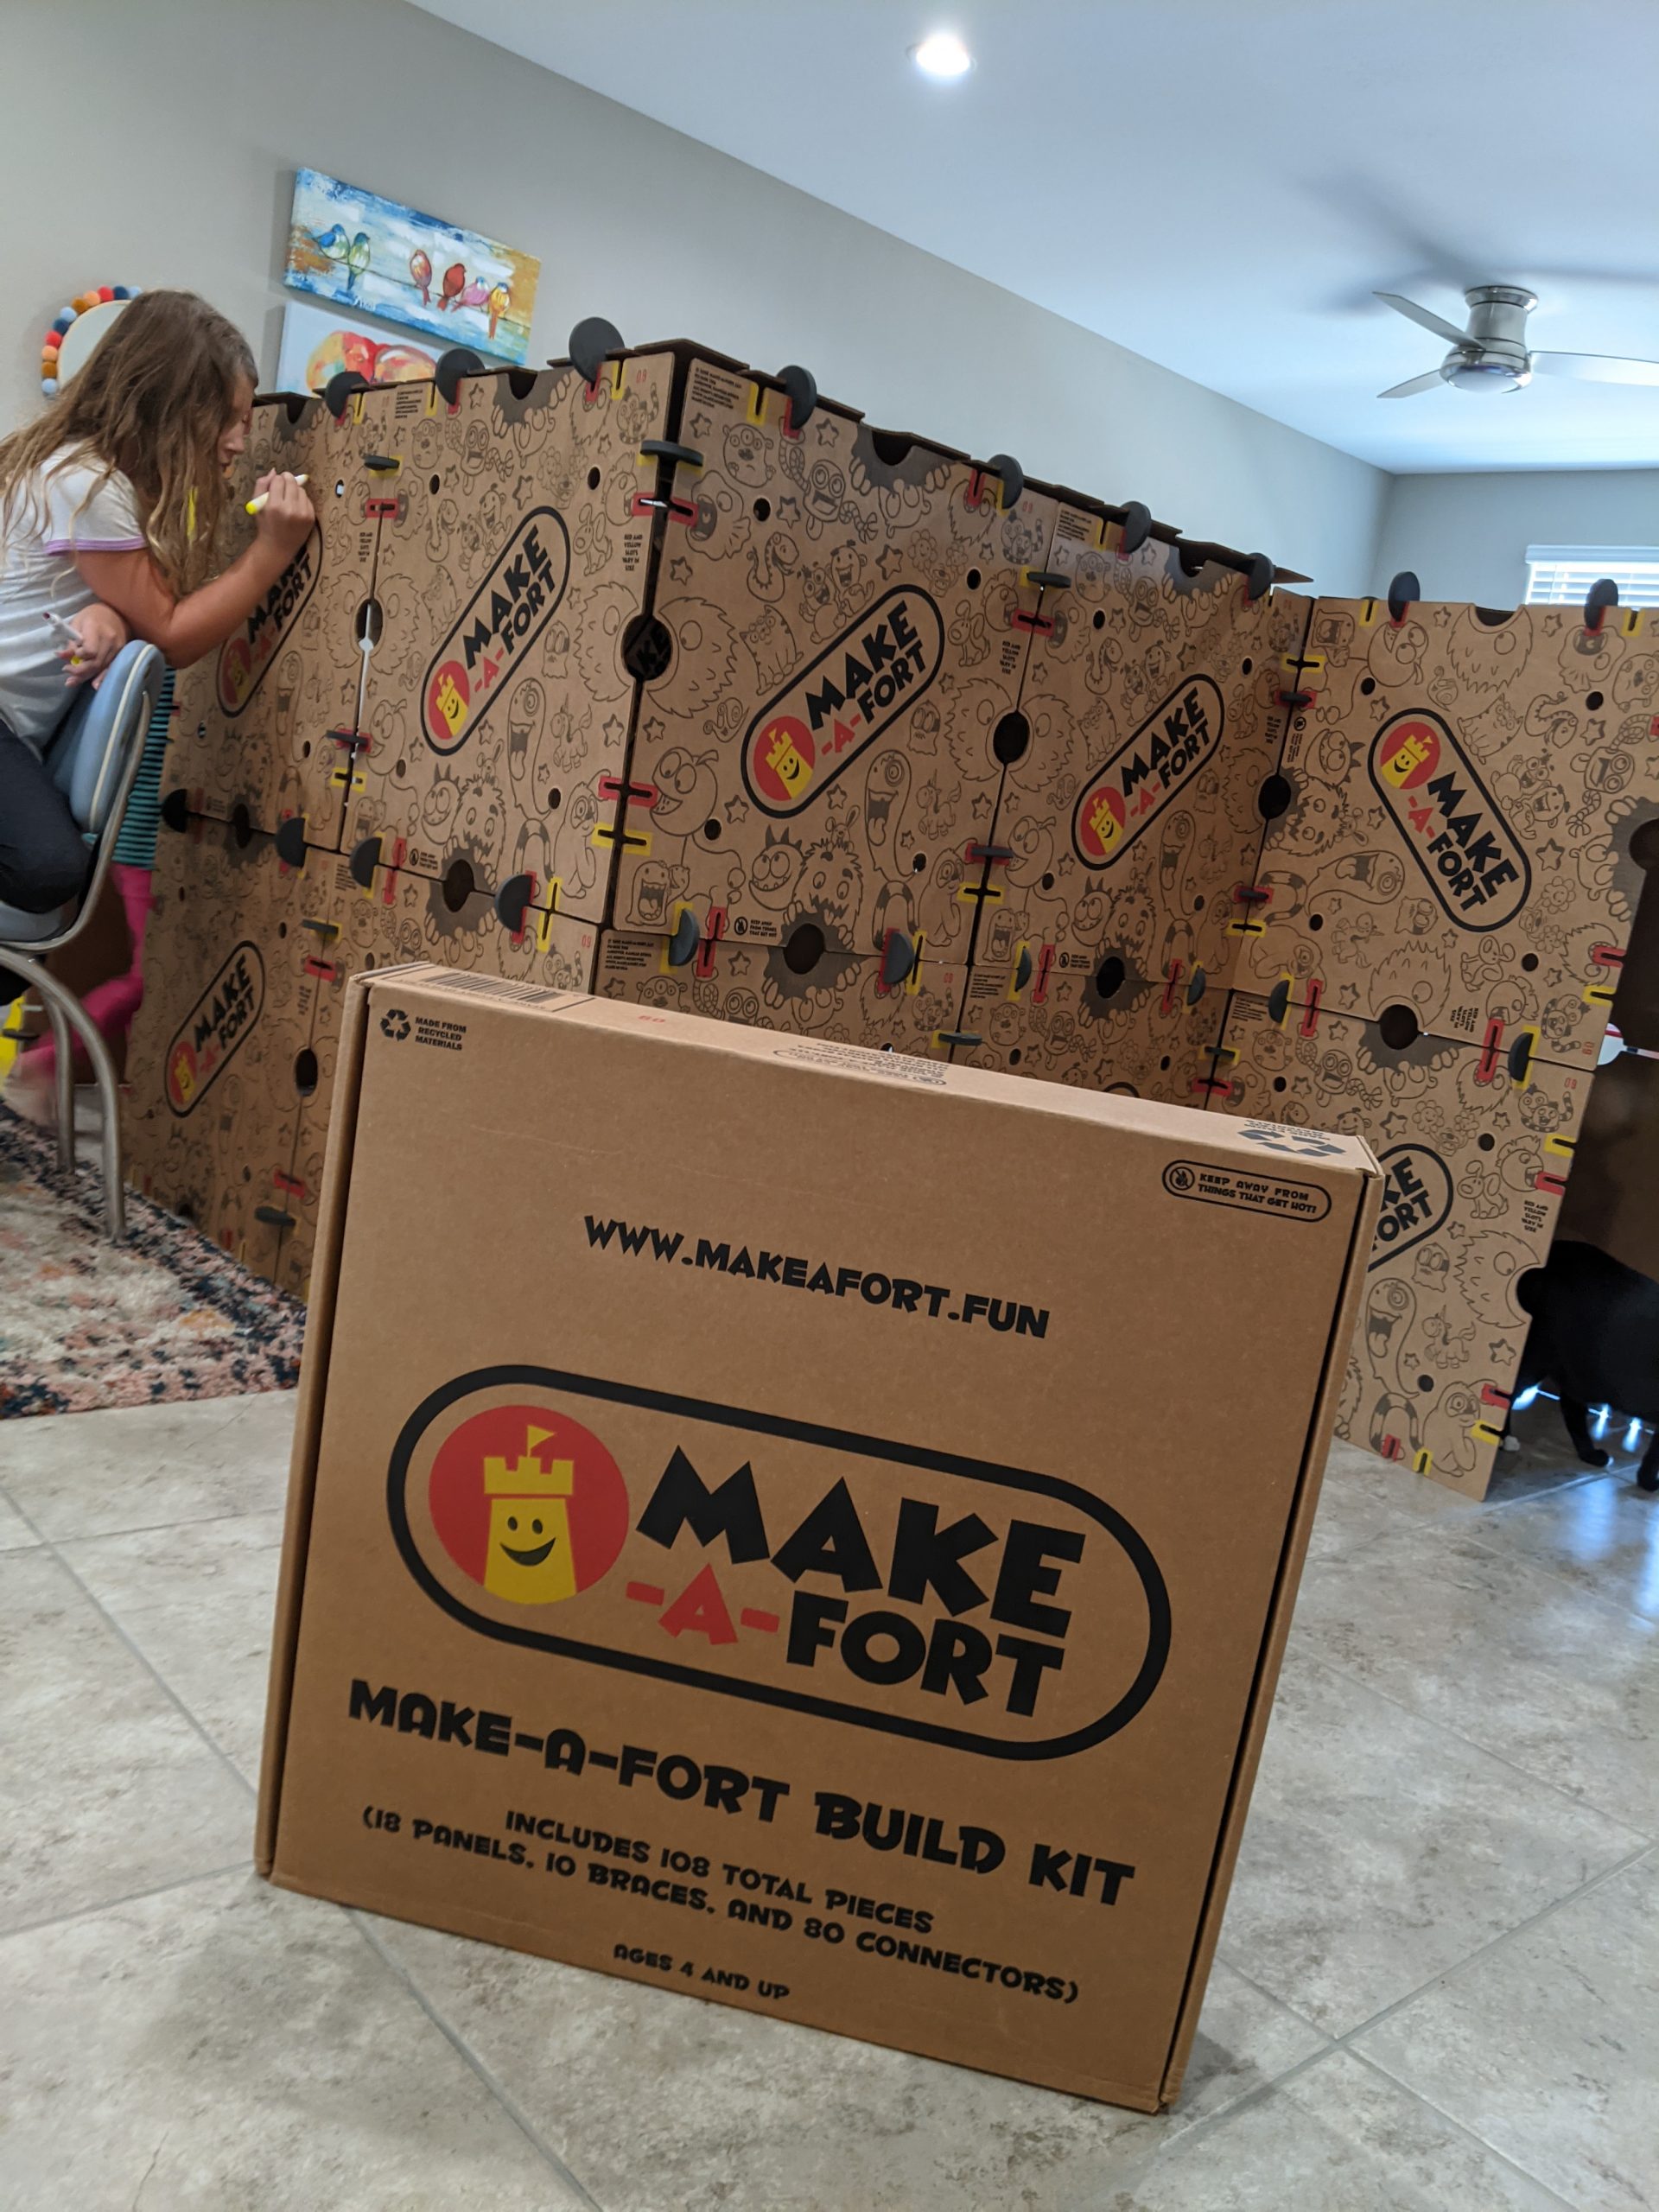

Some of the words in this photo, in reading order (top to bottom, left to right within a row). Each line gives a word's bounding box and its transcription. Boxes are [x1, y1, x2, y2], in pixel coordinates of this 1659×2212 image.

[274, 553, 312, 632] FORT
[463, 524, 548, 671] MAKE
[501, 559, 556, 655] FORT
[805, 600, 918, 731] MAKE
[857, 639, 925, 724] FORT
[1121, 686, 1205, 798] MAKE
[1158, 718, 1210, 790] FORT
[1427, 771, 1520, 899] MAKE
[1427, 831, 1487, 912] FORT
[194, 954, 251, 1052] MAKE
[219, 983, 254, 1050] FORT
[415, 1017, 440, 1028] MADE
[442, 1022, 467, 1033] FROM
[415, 1035, 462, 1051] MATERIALS
[418, 1027, 461, 1041] RECYCLED
[1198, 1183, 1236, 1198] THINGS
[1239, 1192, 1265, 1204] THAT
[1267, 1198, 1289, 1209] GET
[1290, 1202, 1317, 1213] HOT!
[1199, 1173, 1230, 1186] KEEP
[1236, 1180, 1268, 1193] AWAY
[1274, 1188, 1309, 1201] FROM
[1372, 1189, 1433, 1252] ORT
[1380, 1156, 1424, 1212] KE
[584, 1215, 1050, 1338] WWW.MAKEAFORT.FUN
[637, 1444, 1086, 1638] MAKE
[626, 1563, 780, 1645] -A-
[786, 1590, 1065, 1718] FORT
[348, 1679, 791, 1823] MAKE-A-FORT
[815, 1791, 1006, 1875] BUILD
[1028, 1844, 1135, 1906] KIT
[362, 1805, 402, 1834] (18
[546, 1852, 576, 1877] 10
[728, 1899, 793, 1931] AND
[804, 1917, 845, 1945] 80
[855, 1931, 1079, 2005] CONNECTORS)
[505, 1809, 650, 1864] INCLUDES
[660, 1847, 710, 1878] 108
[722, 1864, 812, 1904] TOTAL
[825, 1889, 935, 1935] PIECES
[613, 1943, 672, 1972] AGES
[680, 1961, 694, 1978] 4
[702, 1967, 750, 1992] AND
[758, 1980, 790, 1999] UP
